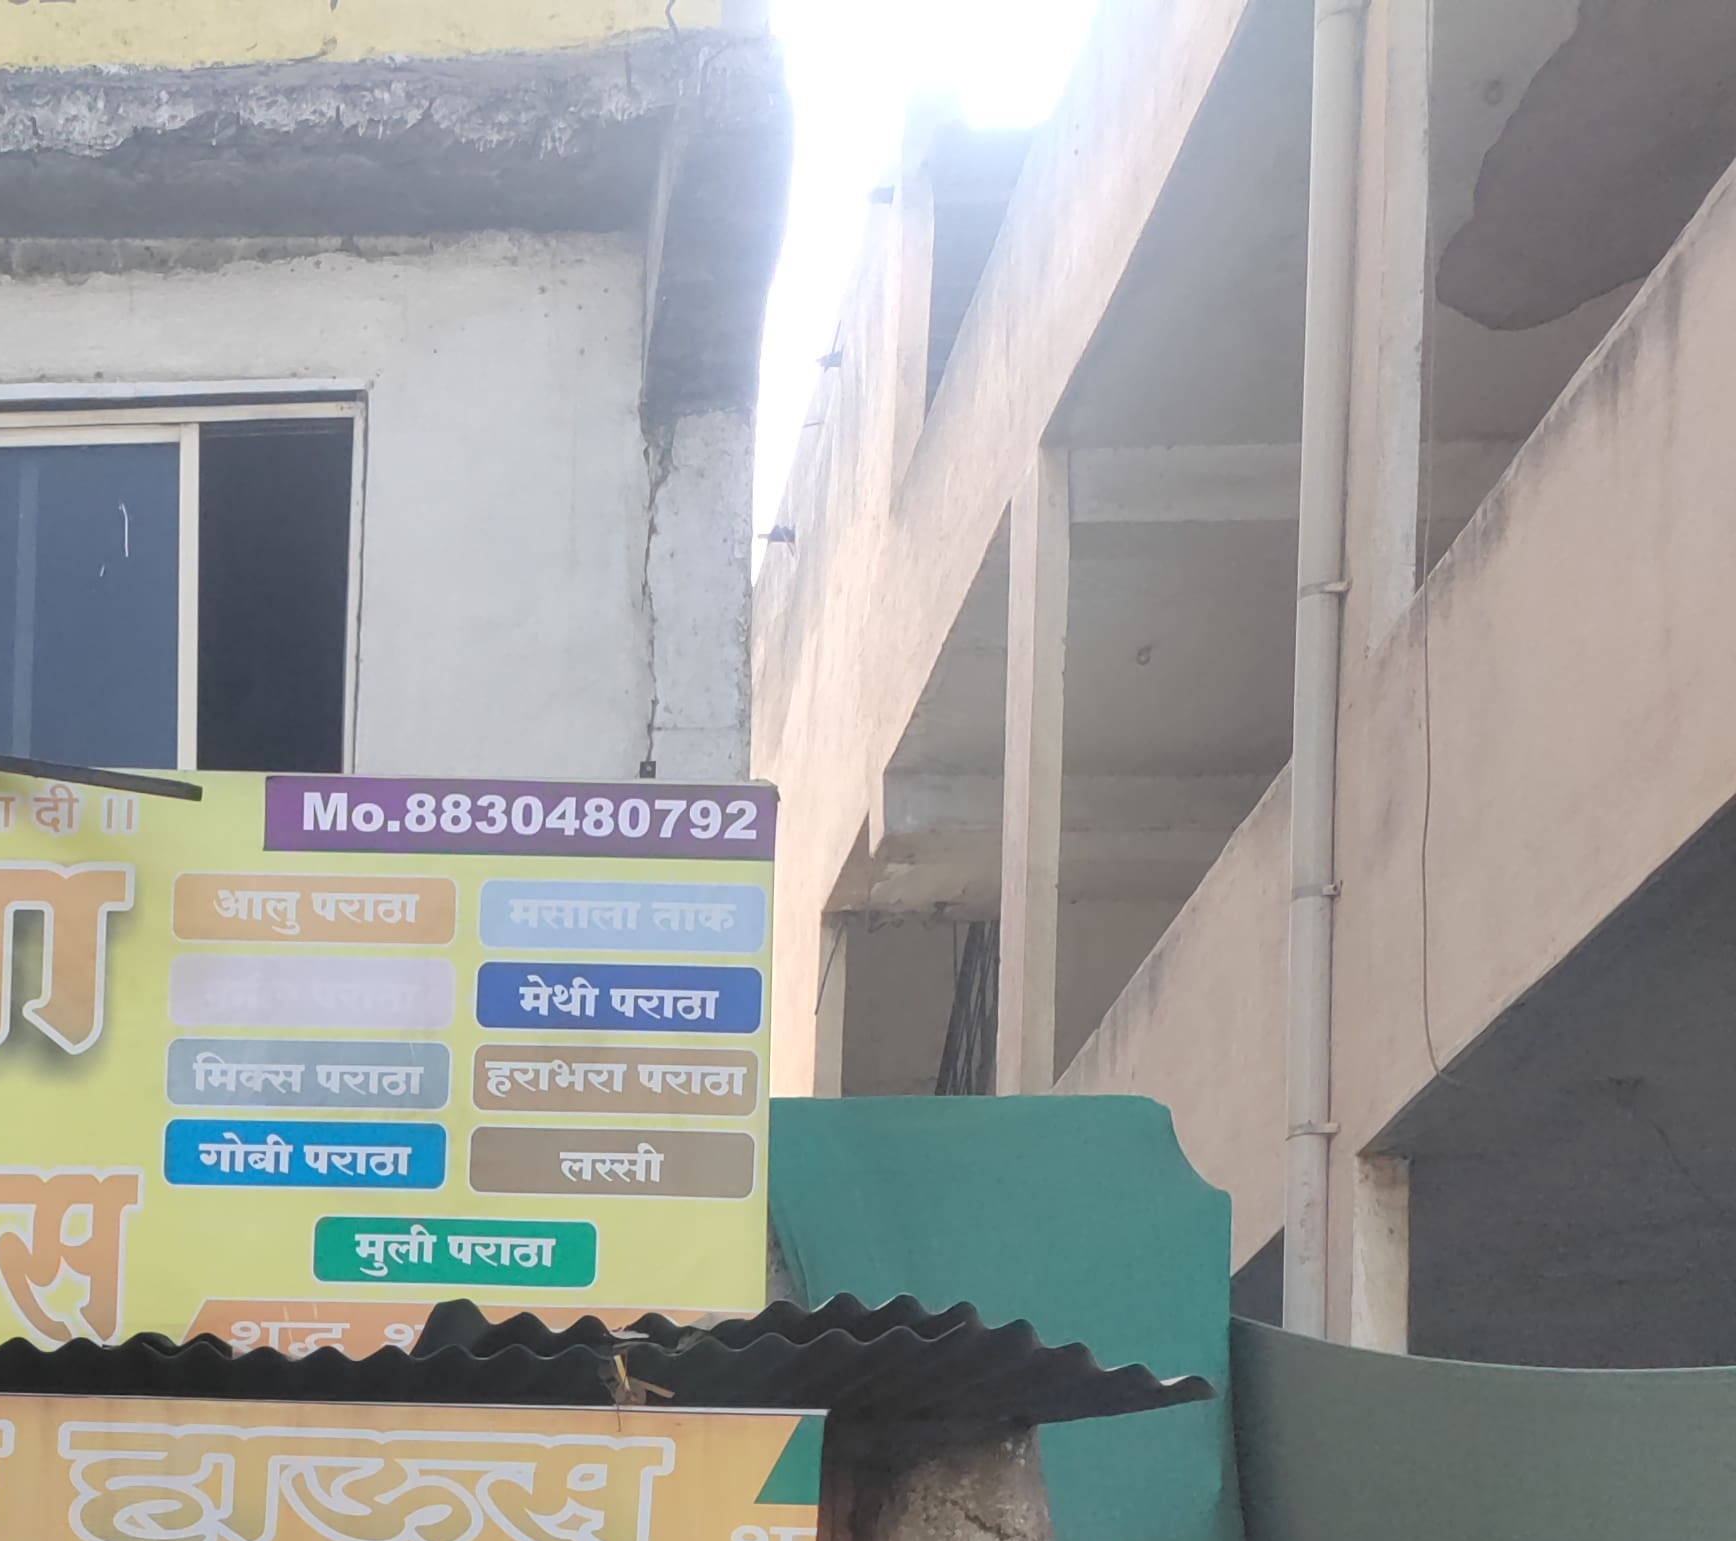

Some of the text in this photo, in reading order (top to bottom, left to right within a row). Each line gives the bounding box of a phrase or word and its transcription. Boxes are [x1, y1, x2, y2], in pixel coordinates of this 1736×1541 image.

[33, 783, 79, 833] दी
[301, 792, 759, 841] Mo.8830480792
[214, 888, 420, 936] आलु पराठा
[518, 974, 720, 1021] मेथी पराठा
[192, 1051, 425, 1096] मिक्स पराठा
[485, 1058, 748, 1099] हराभरा पराठा
[199, 1131, 412, 1177] गोबी पराठा
[559, 1141, 665, 1183] लस्सी
[354, 1222, 556, 1277] मुली पराठा
